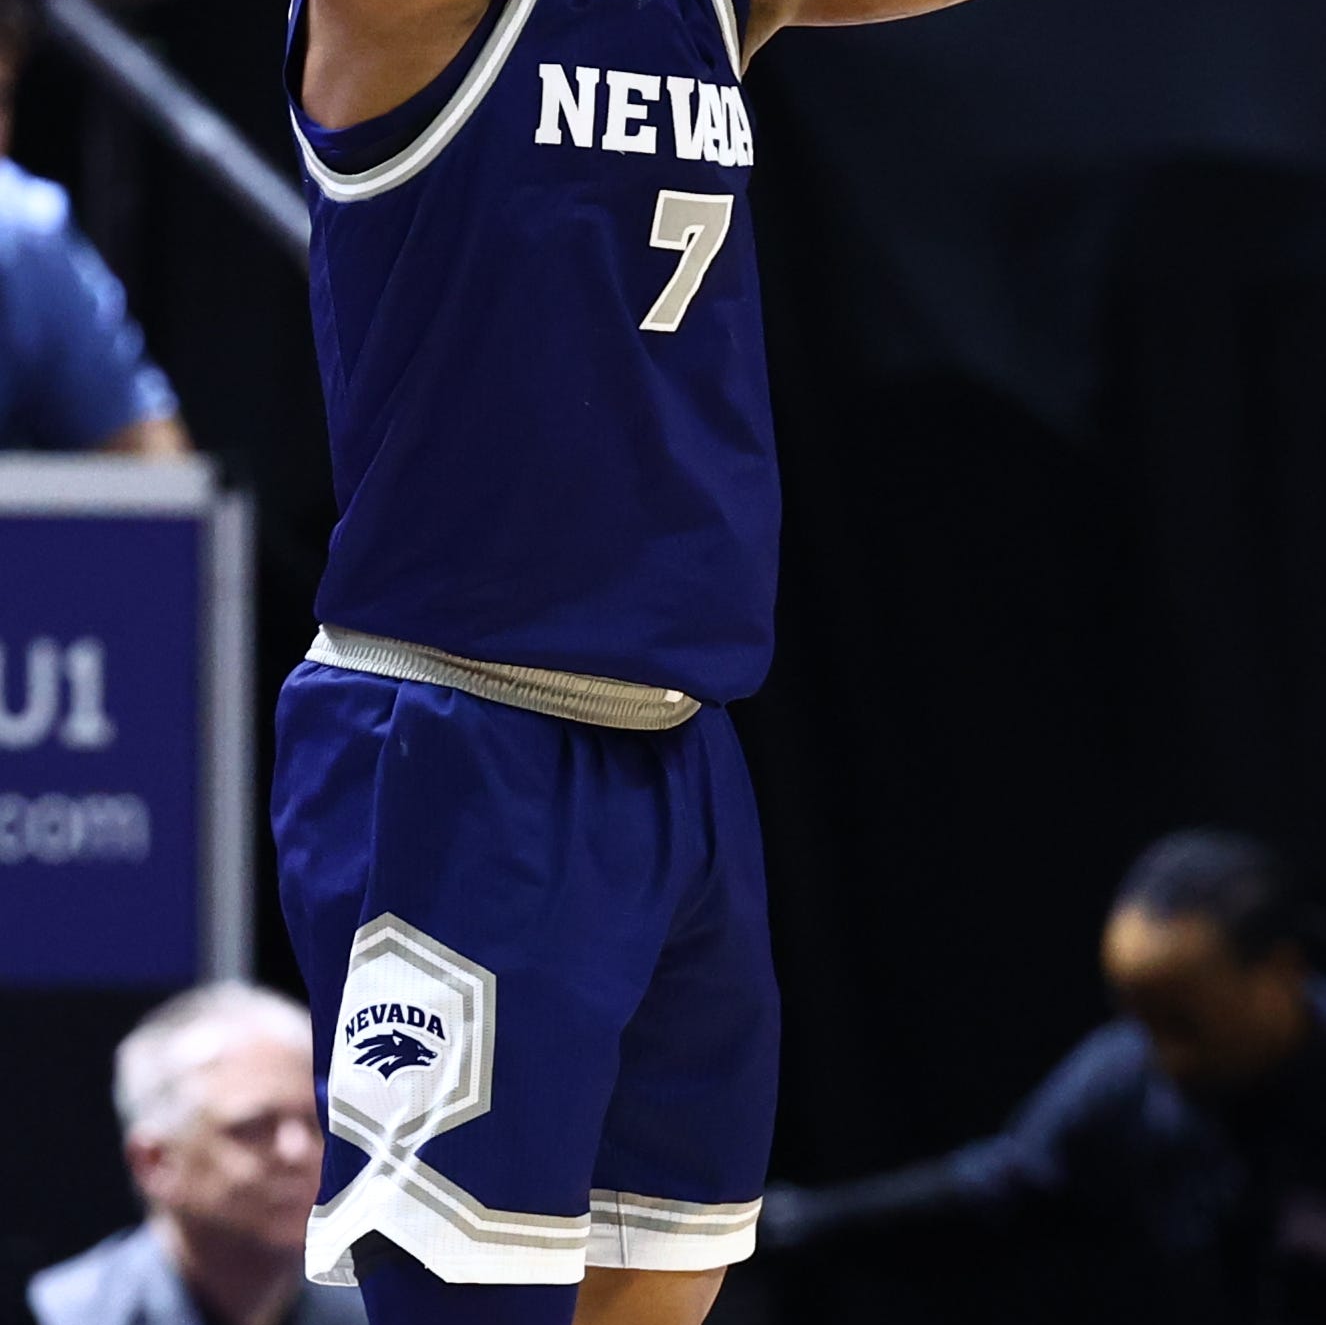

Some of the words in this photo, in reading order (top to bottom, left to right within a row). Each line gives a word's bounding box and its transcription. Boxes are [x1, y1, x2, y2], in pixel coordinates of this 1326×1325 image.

[534, 63, 754, 167] NEVADA
[638, 189, 735, 333] 7
[345, 1003, 446, 1046] NEVADA
